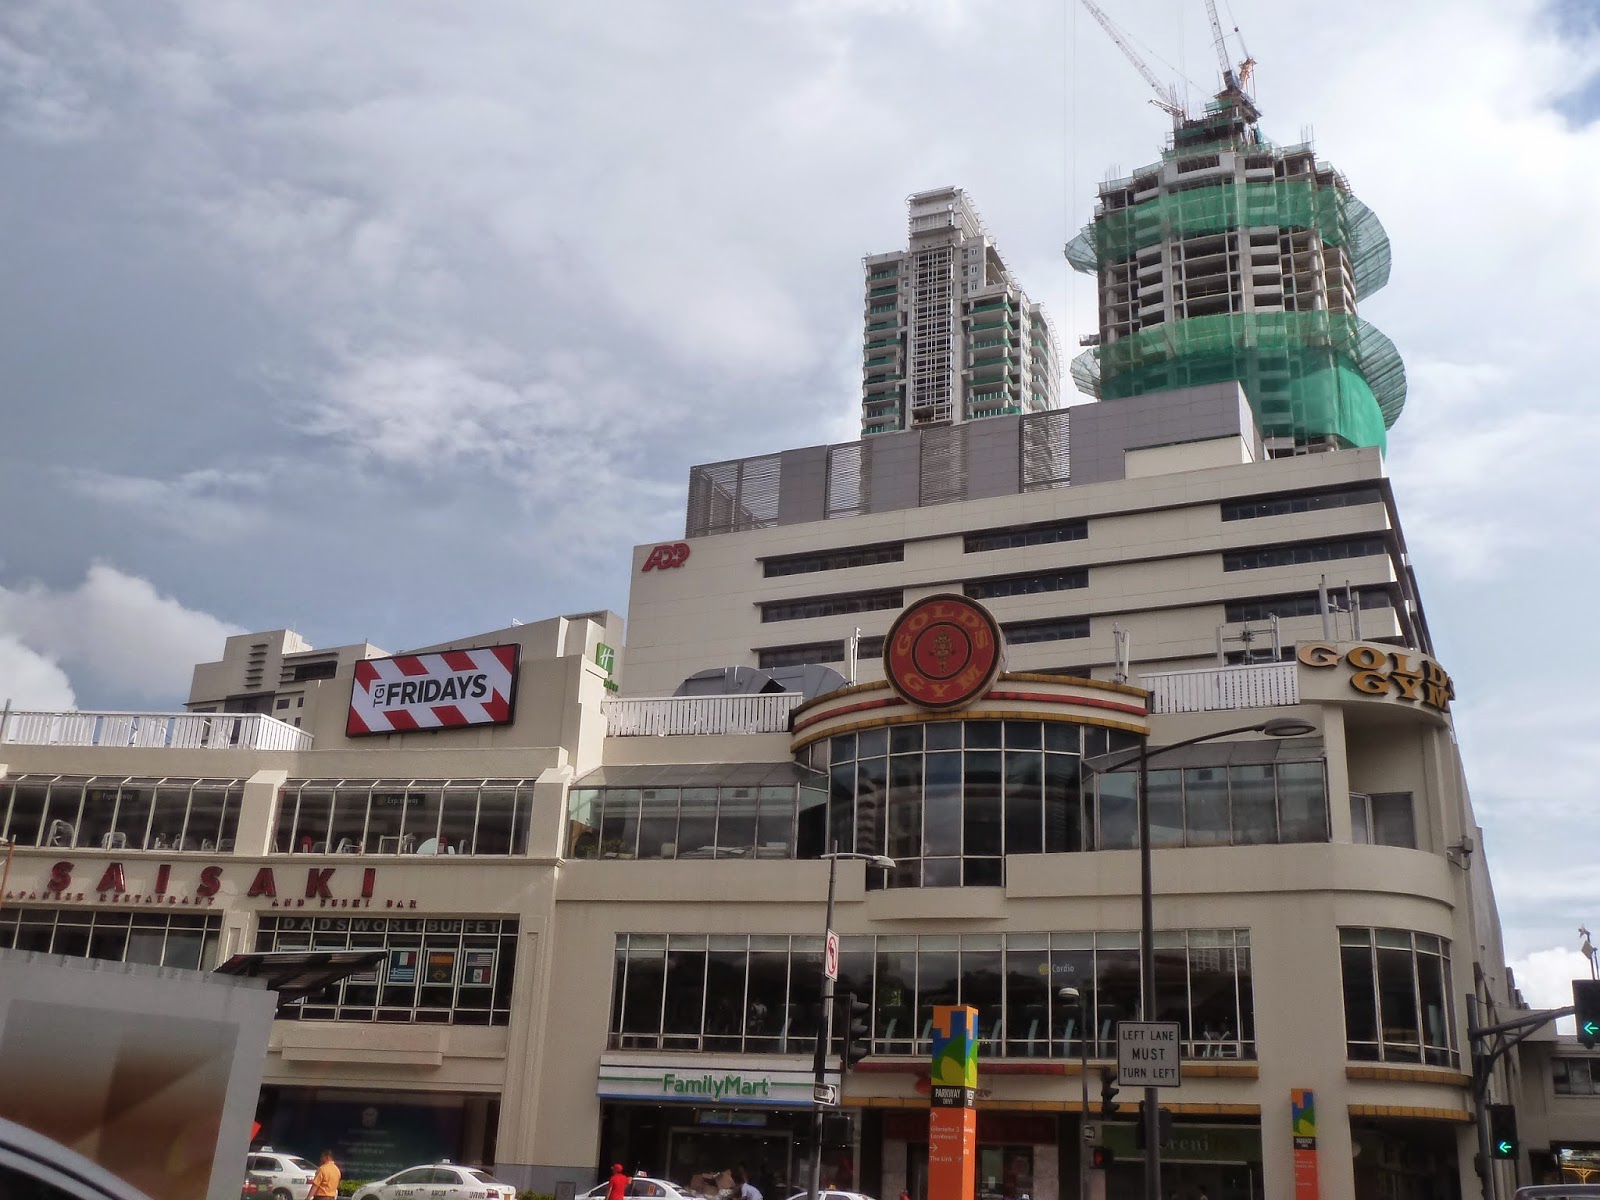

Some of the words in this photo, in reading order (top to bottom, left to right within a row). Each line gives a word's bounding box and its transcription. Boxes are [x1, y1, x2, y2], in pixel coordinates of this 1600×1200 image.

[641, 543, 690, 572] ADP
[386, 674, 487, 706] FRIDAYS
[904, 664, 983, 697] GYM
[1350, 670, 1450, 713] GYM
[373, 684, 385, 708] TGI
[47, 861, 376, 898] SAISAKI
[6, 890, 84, 901] APANESE
[100, 894, 215, 905] RESTAURANT
[272, 898, 305, 907] AND
[320, 898, 370, 908] SUSHI
[386, 899, 417, 908] BAR
[1123, 1031, 1145, 1040] LEFT
[1151, 1031, 1174, 1040] LANE
[1132, 1048, 1165, 1060] MUST
[1122, 1068, 1146, 1078] TURN
[1153, 1068, 1175, 1078] LEFT
[663, 1073, 768, 1098] FamilyMart
[935, 1088, 961, 1098] PARKWAY
